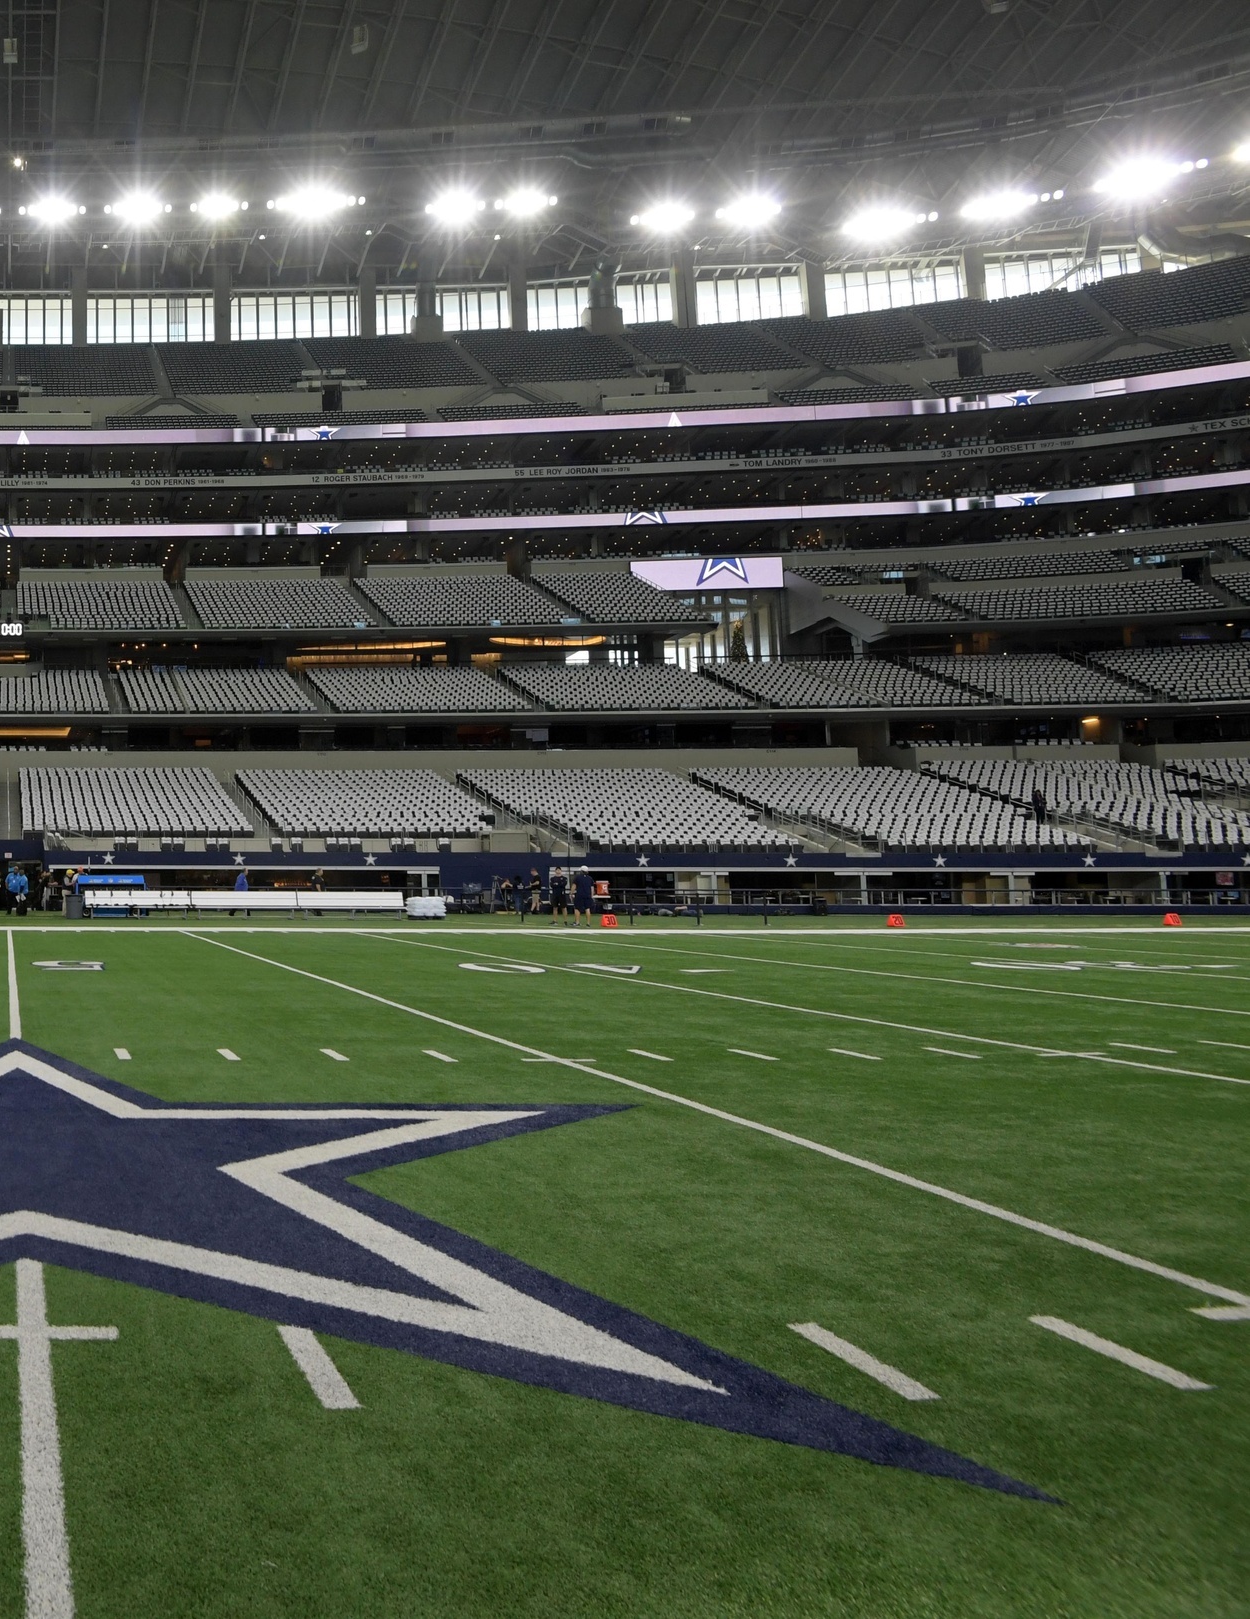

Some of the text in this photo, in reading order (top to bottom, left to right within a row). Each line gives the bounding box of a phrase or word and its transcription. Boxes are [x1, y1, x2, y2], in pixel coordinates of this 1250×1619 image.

[1202, 420, 1227, 430] TEX
[940, 450, 952, 458] 33
[956, 447, 984, 457] TONY
[988, 443, 1036, 454] DORSETT
[766, 458, 802, 467] LANDRY
[565, 467, 598, 475] JORDAN
[1, 623, 22, 636] 0:00
